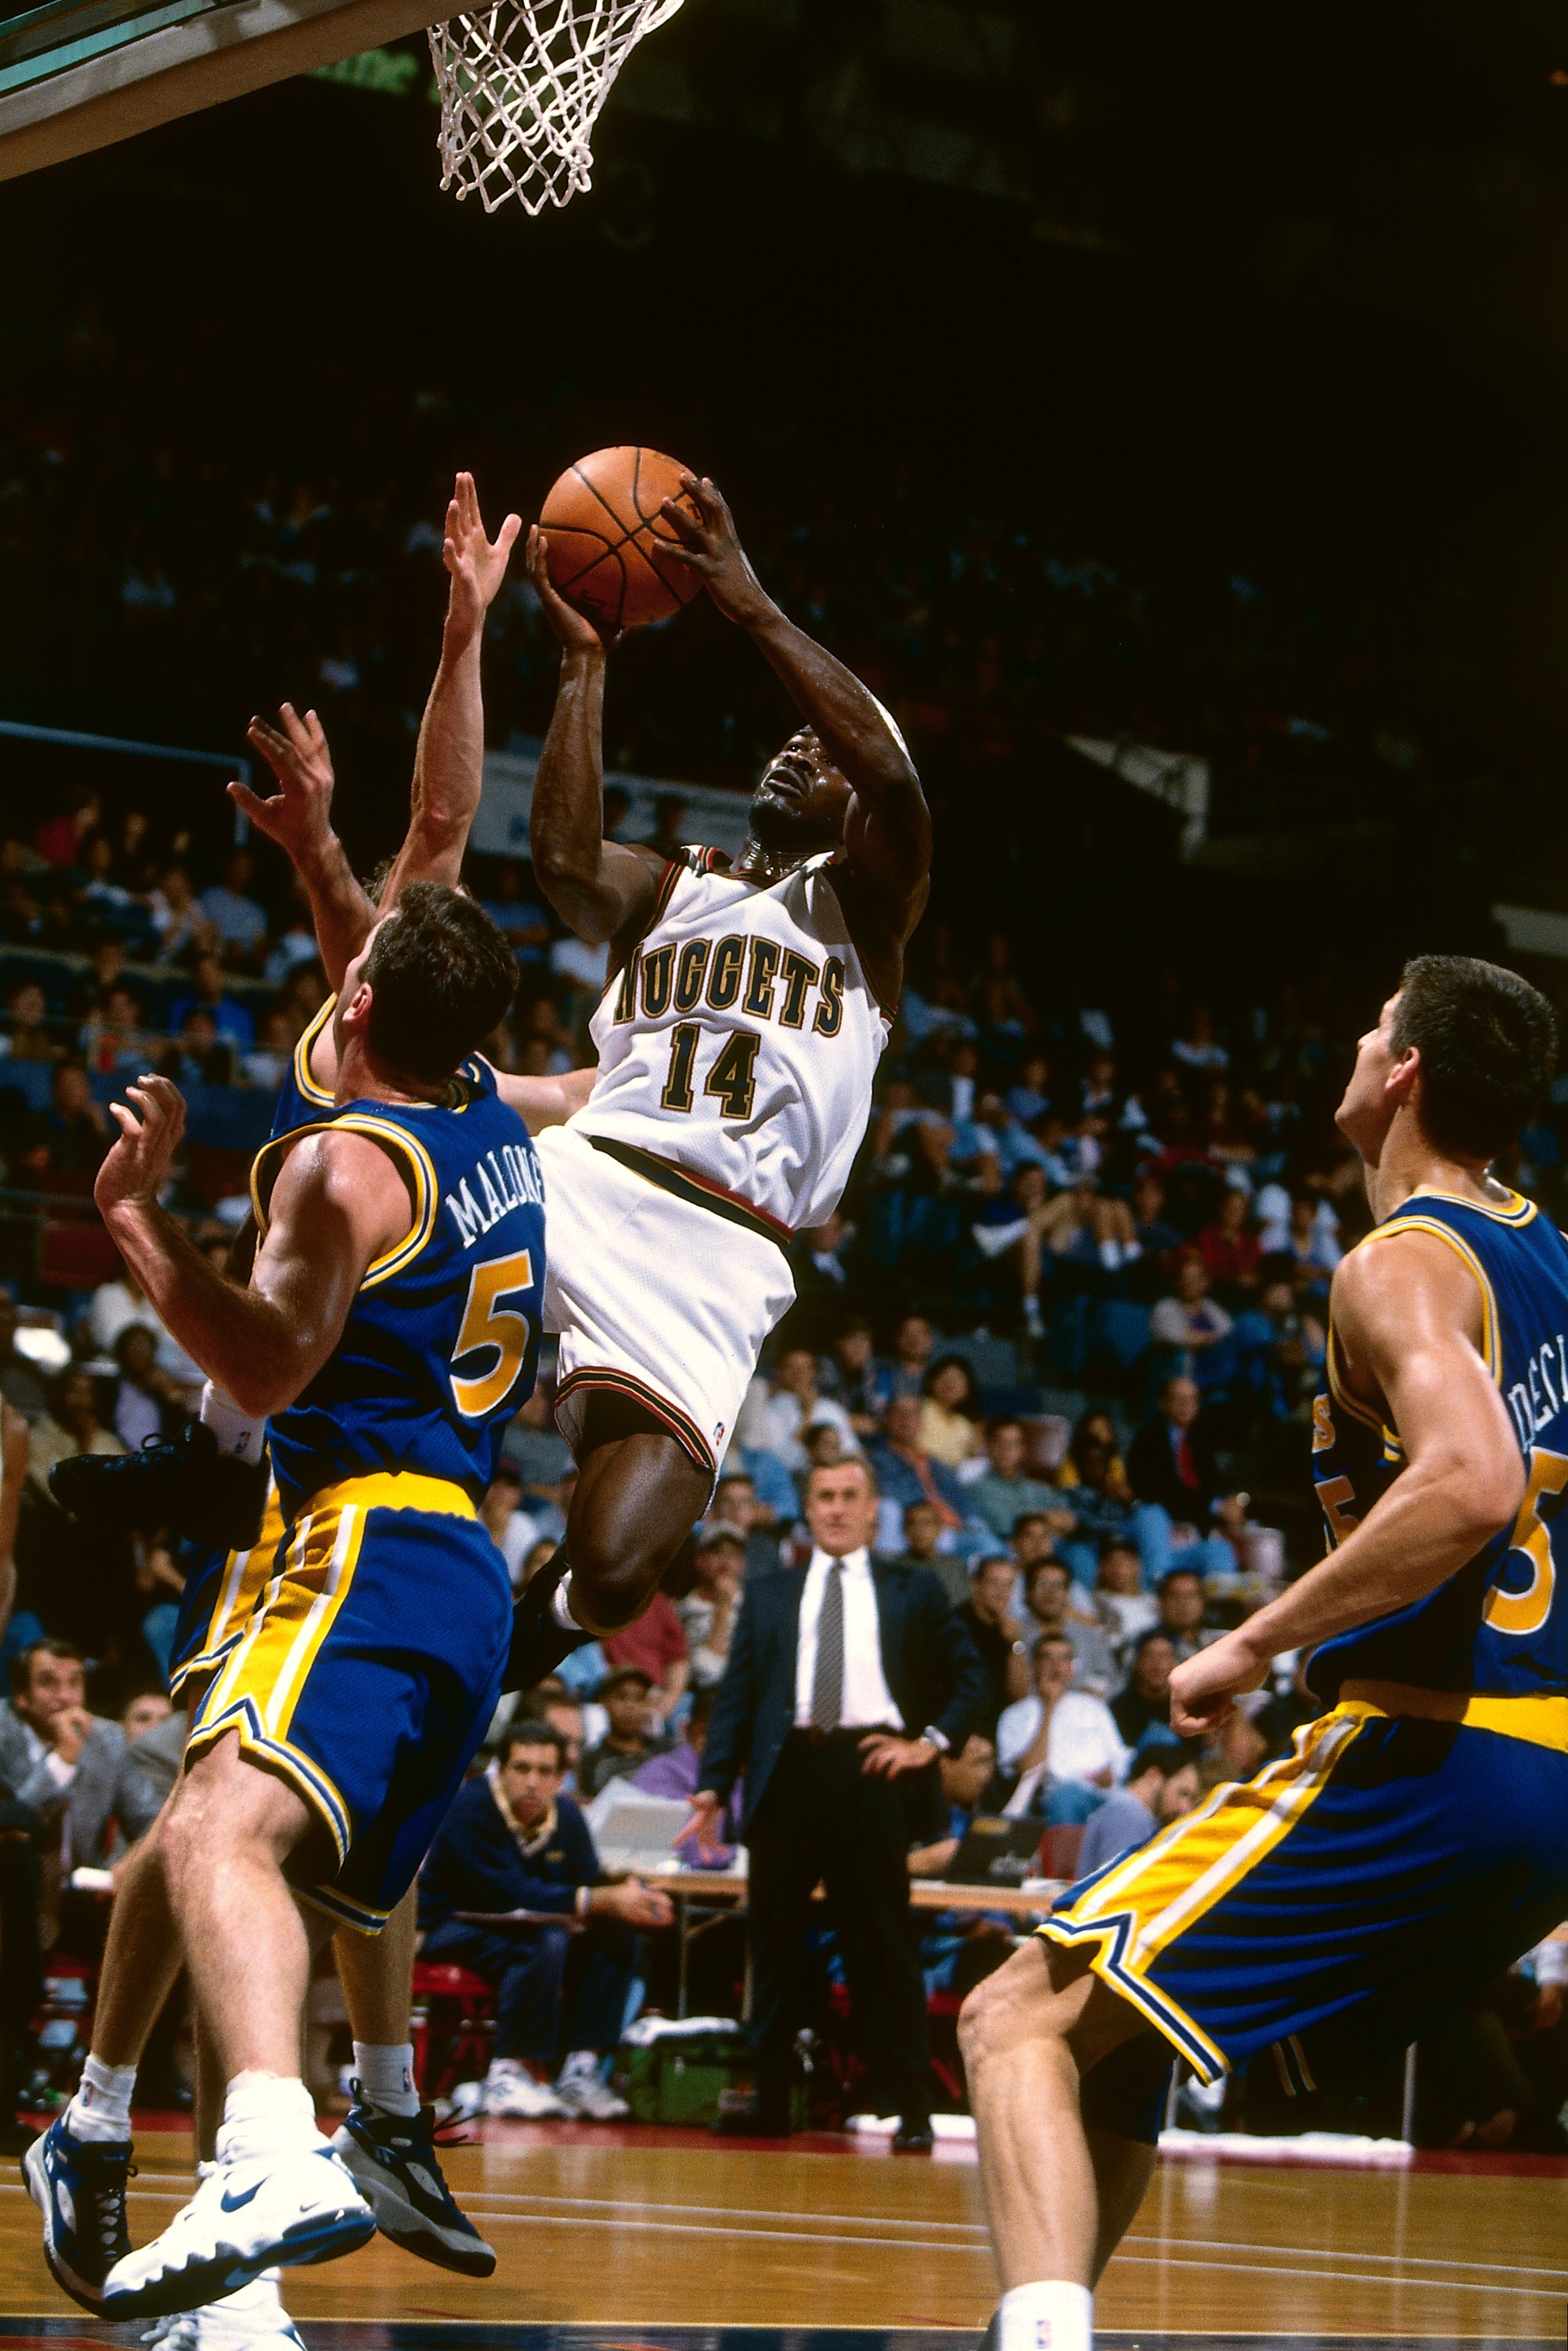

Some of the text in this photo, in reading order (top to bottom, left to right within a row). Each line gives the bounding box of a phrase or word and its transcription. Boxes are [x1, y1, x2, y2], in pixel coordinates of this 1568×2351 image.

[612, 933, 845, 1038] NUGGETS
[660, 1021, 762, 1121] 14
[449, 1247, 534, 1419] 5
